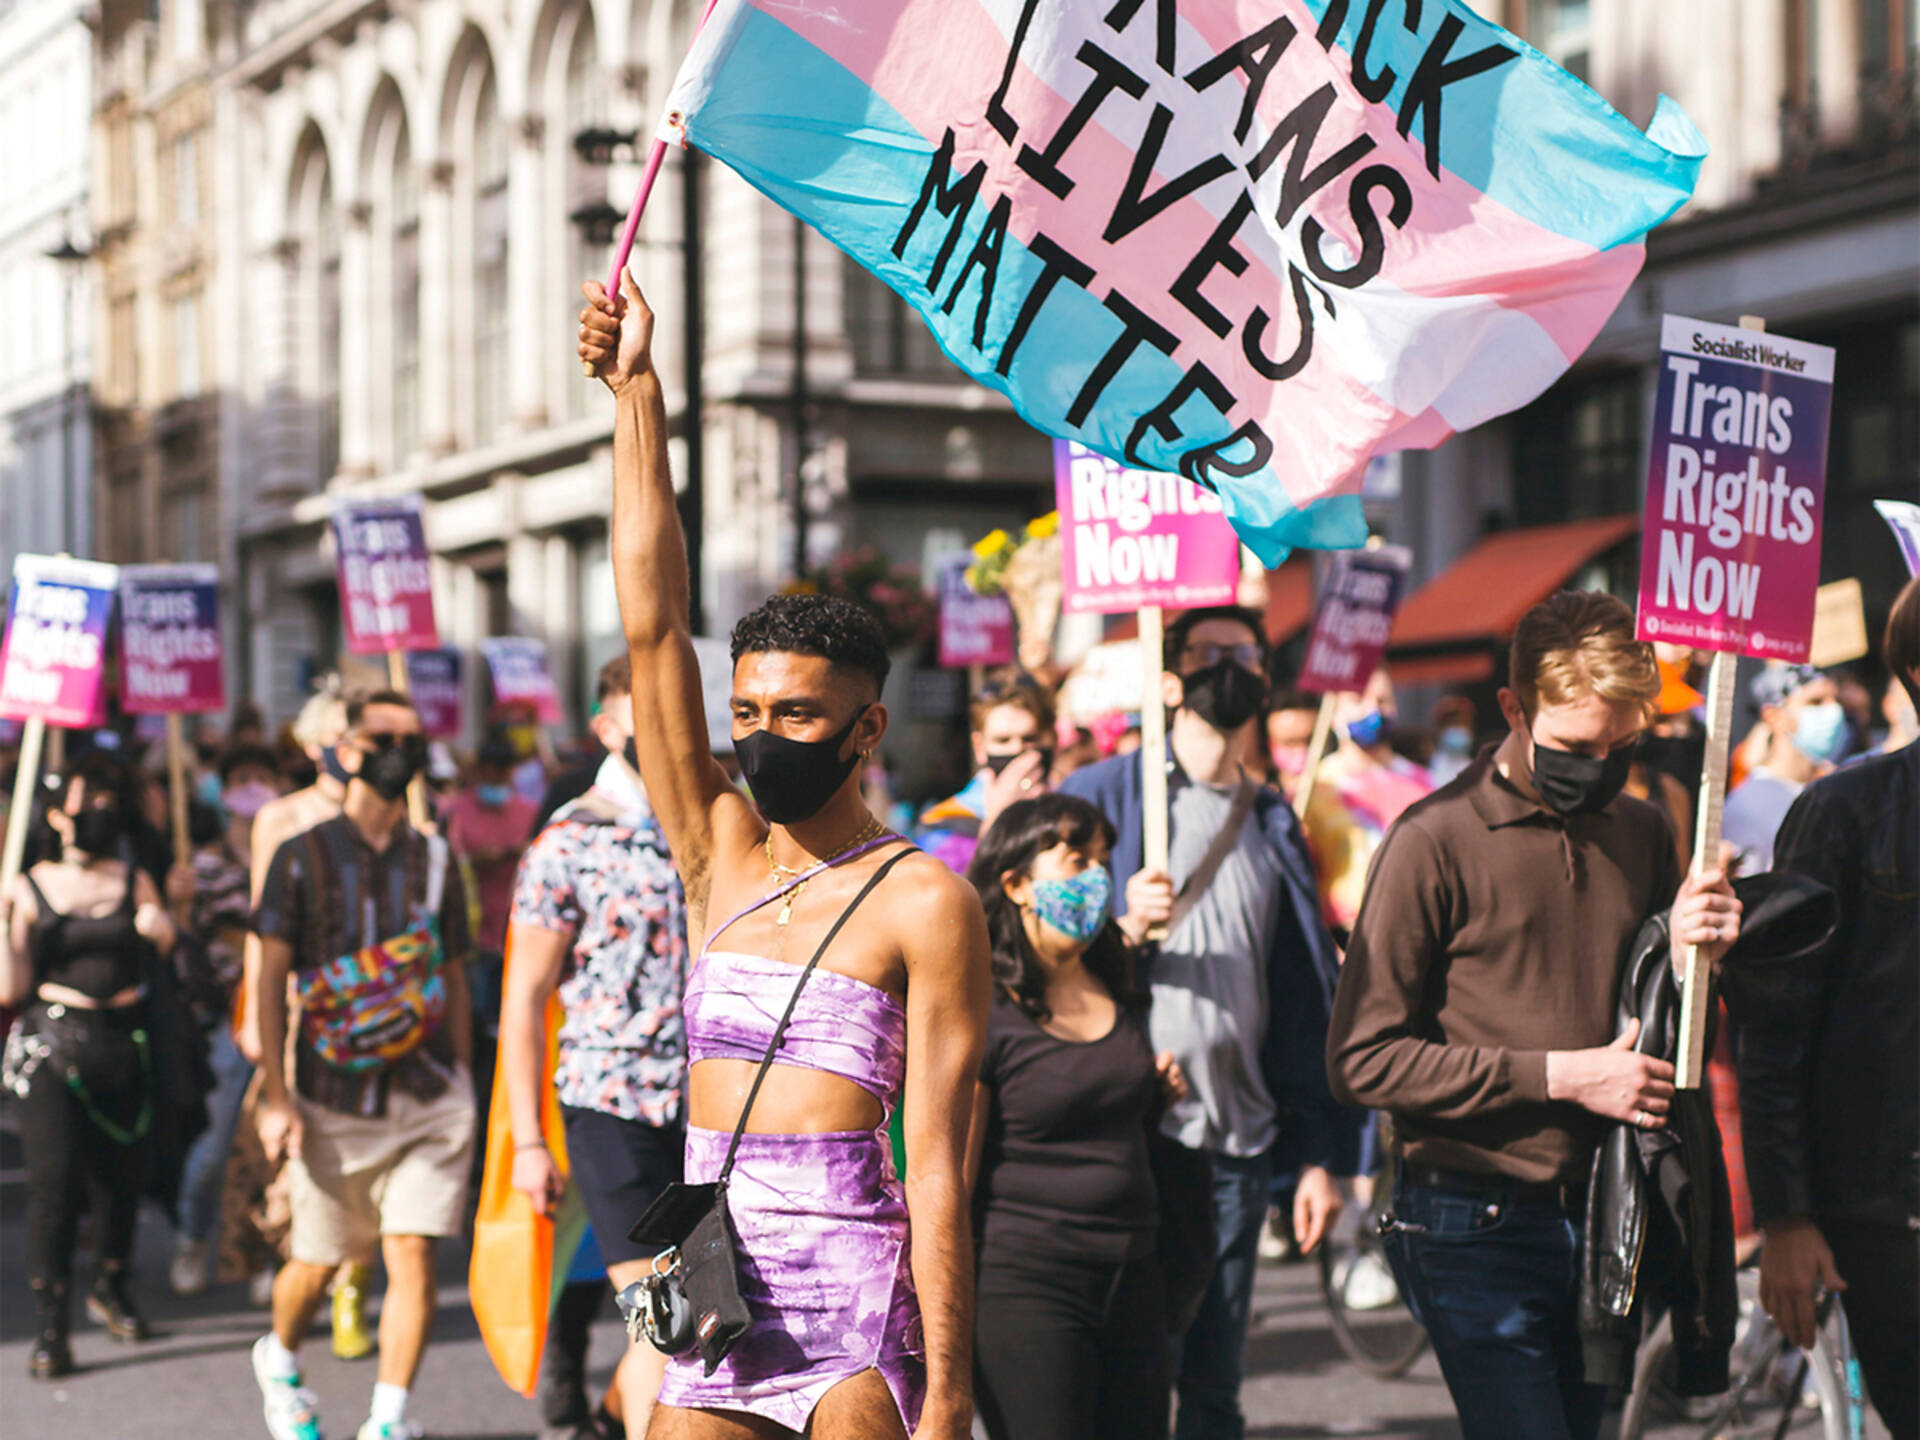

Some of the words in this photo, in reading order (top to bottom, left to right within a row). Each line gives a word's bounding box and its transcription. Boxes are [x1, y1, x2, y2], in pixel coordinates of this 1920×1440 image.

[1315, 0, 1522, 183] CK
[985, 0, 1337, 381] LIVES
[891, 126, 1273, 494] MATTER
[1691, 332, 1758, 363] Socialist
[1759, 343, 1807, 373] Worker
[1667, 355, 1794, 455] Trans
[335, 511, 411, 552] Trans
[1662, 443, 1815, 549] Rights
[343, 552, 431, 605] Rights
[1073, 522, 1179, 588] Now
[1655, 529, 1761, 620] Now
[123, 619, 217, 669] Rights
[126, 660, 192, 699] Now
